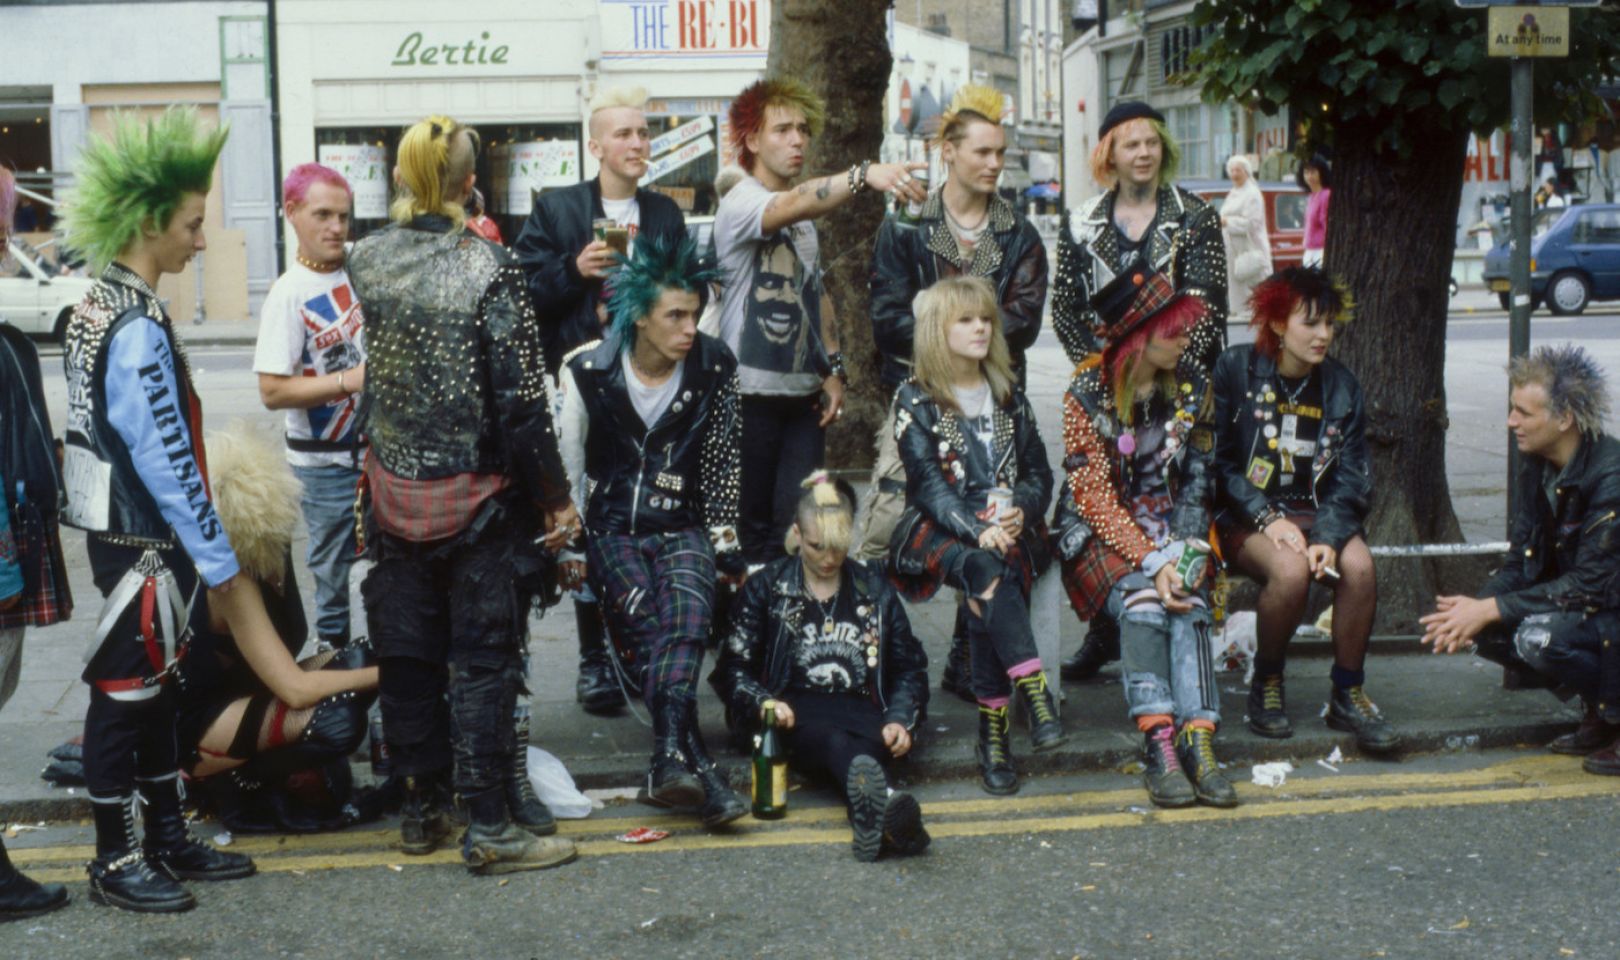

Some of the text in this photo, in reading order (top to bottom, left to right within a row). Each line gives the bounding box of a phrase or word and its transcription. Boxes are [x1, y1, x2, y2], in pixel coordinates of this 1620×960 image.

[630, 5, 671, 49] THE
[1496, 34, 1562, 47] At any time
[391, 31, 509, 66] Bertie
[137, 362, 223, 542] PARTISANS
